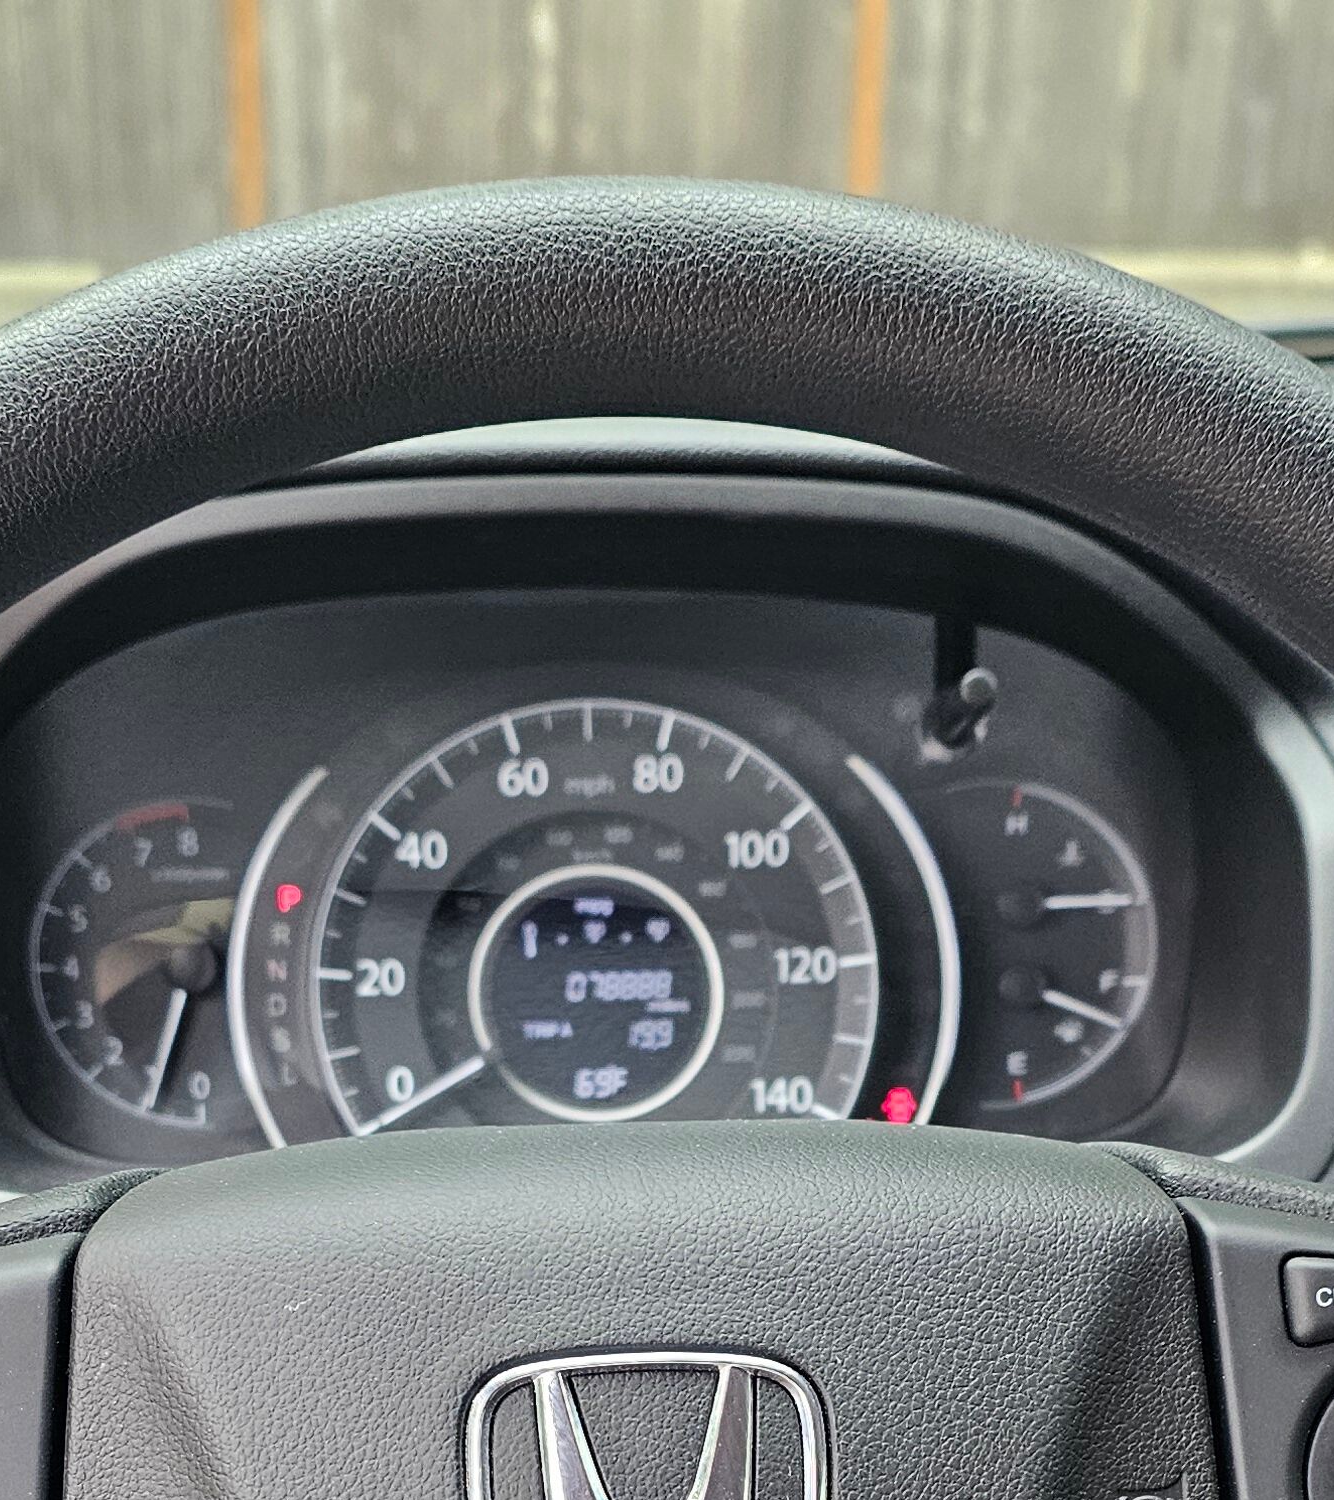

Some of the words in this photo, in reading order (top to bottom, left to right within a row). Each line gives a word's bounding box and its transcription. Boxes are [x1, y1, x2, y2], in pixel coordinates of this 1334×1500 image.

[497, 757, 550, 799] 60
[632, 752, 685, 794] 80
[1005, 813, 1029, 836] H
[133, 837, 154, 868] 7
[176, 826, 200, 858] 8
[394, 830, 449, 870] 40
[725, 830, 790, 870] 100
[90, 866, 113, 893] 6
[68, 903, 89, 934] 5
[61, 954, 80, 982] 4
[355, 959, 406, 997] 20
[774, 945, 837, 985] 120
[75, 1000, 95, 1030] 3
[101, 1036, 124, 1066] 2
[1006, 1050, 1028, 1077] E
[187, 1071, 212, 1100] 0
[385, 1065, 414, 1101] 0
[750, 1075, 814, 1114] 140
